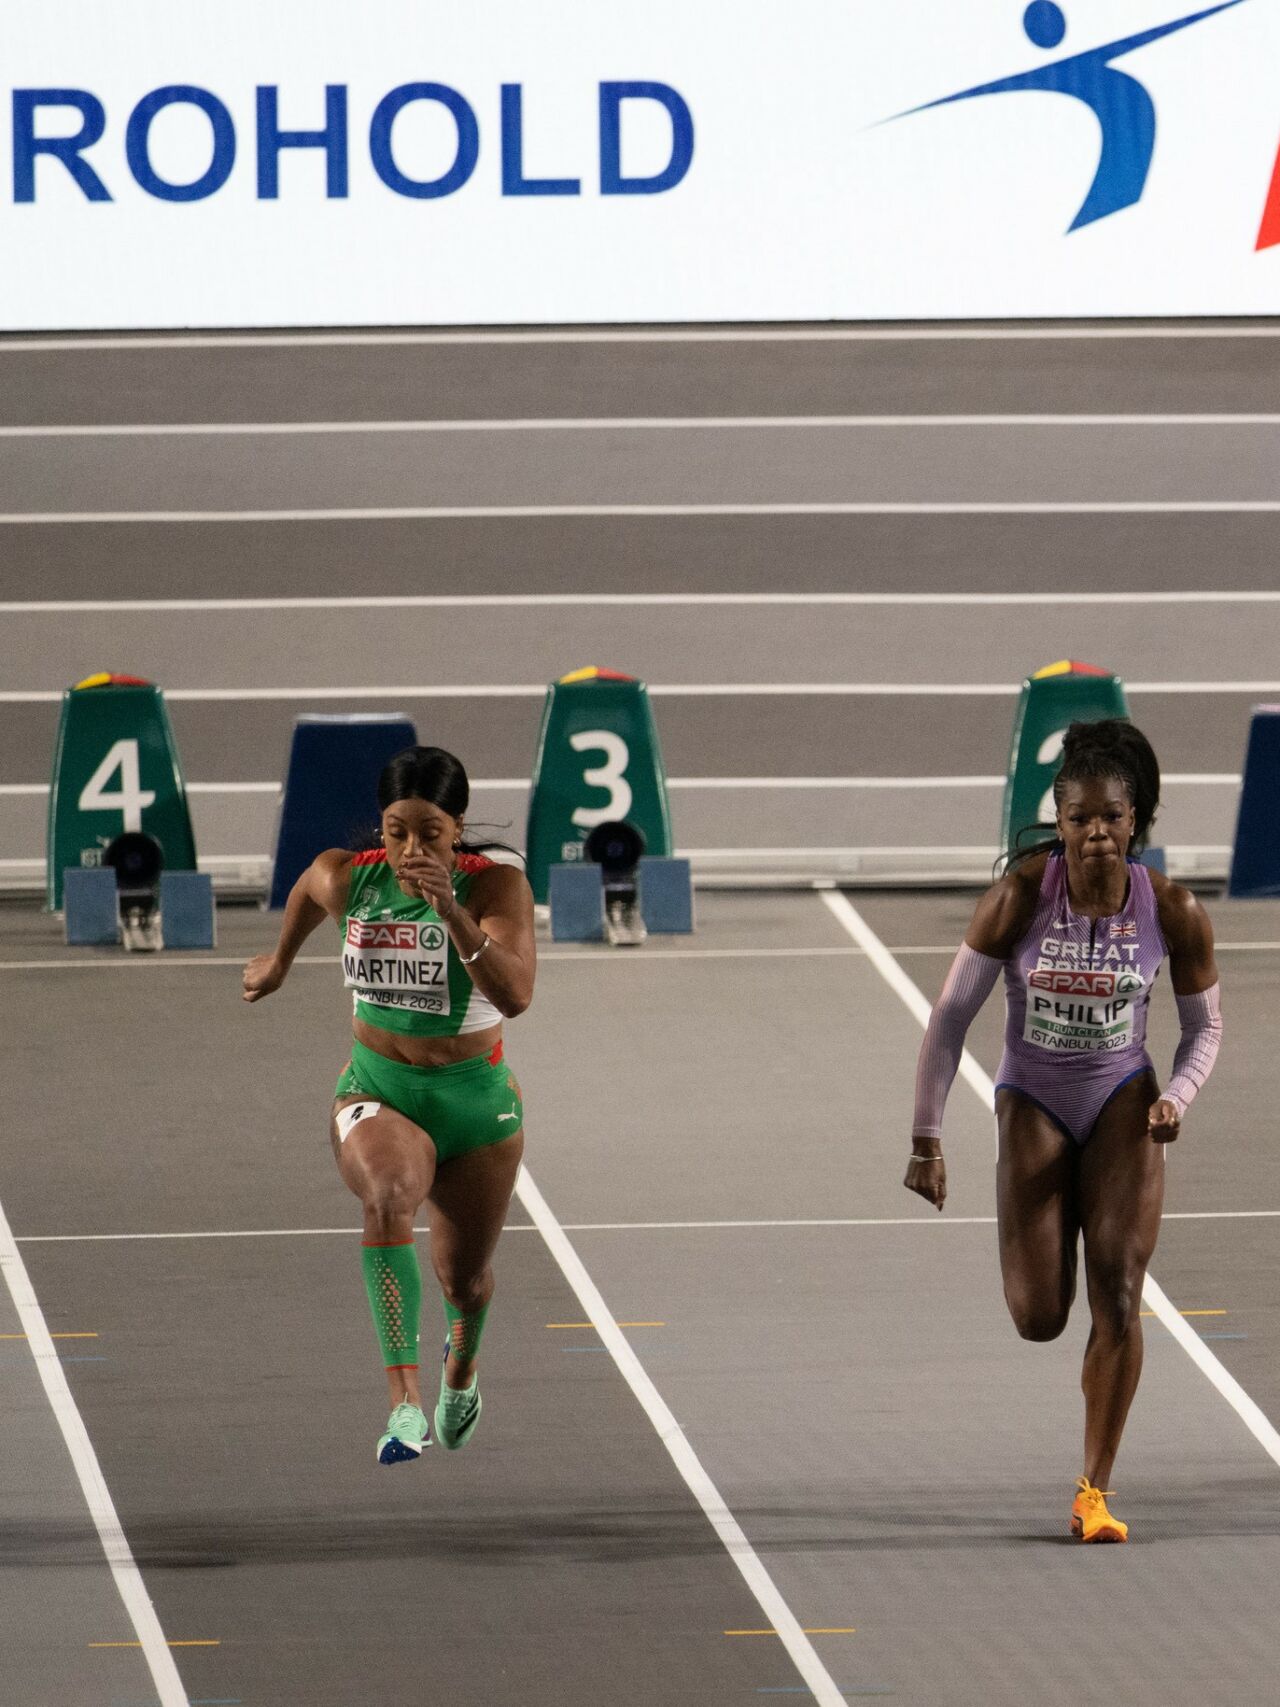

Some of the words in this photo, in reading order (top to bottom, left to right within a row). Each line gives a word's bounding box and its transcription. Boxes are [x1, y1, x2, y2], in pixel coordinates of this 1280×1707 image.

[12, 80, 695, 203] ROHOLD
[78, 737, 156, 832] 4
[568, 729, 633, 827] 3
[349, 923, 416, 946] SPAR
[1040, 937, 1140, 961] GREAT
[344, 953, 445, 986] MARTINEZ
[1032, 973, 1112, 994] SPAR
[410, 996, 444, 1012] 2023
[1034, 996, 1129, 1025] PHILIP
[1031, 1028, 1094, 1050] ISTANBUL
[1097, 1033, 1127, 1051] 2023
[1053, 1023, 1076, 1035] RUN
[1077, 1027, 1112, 1037] CLEAN
